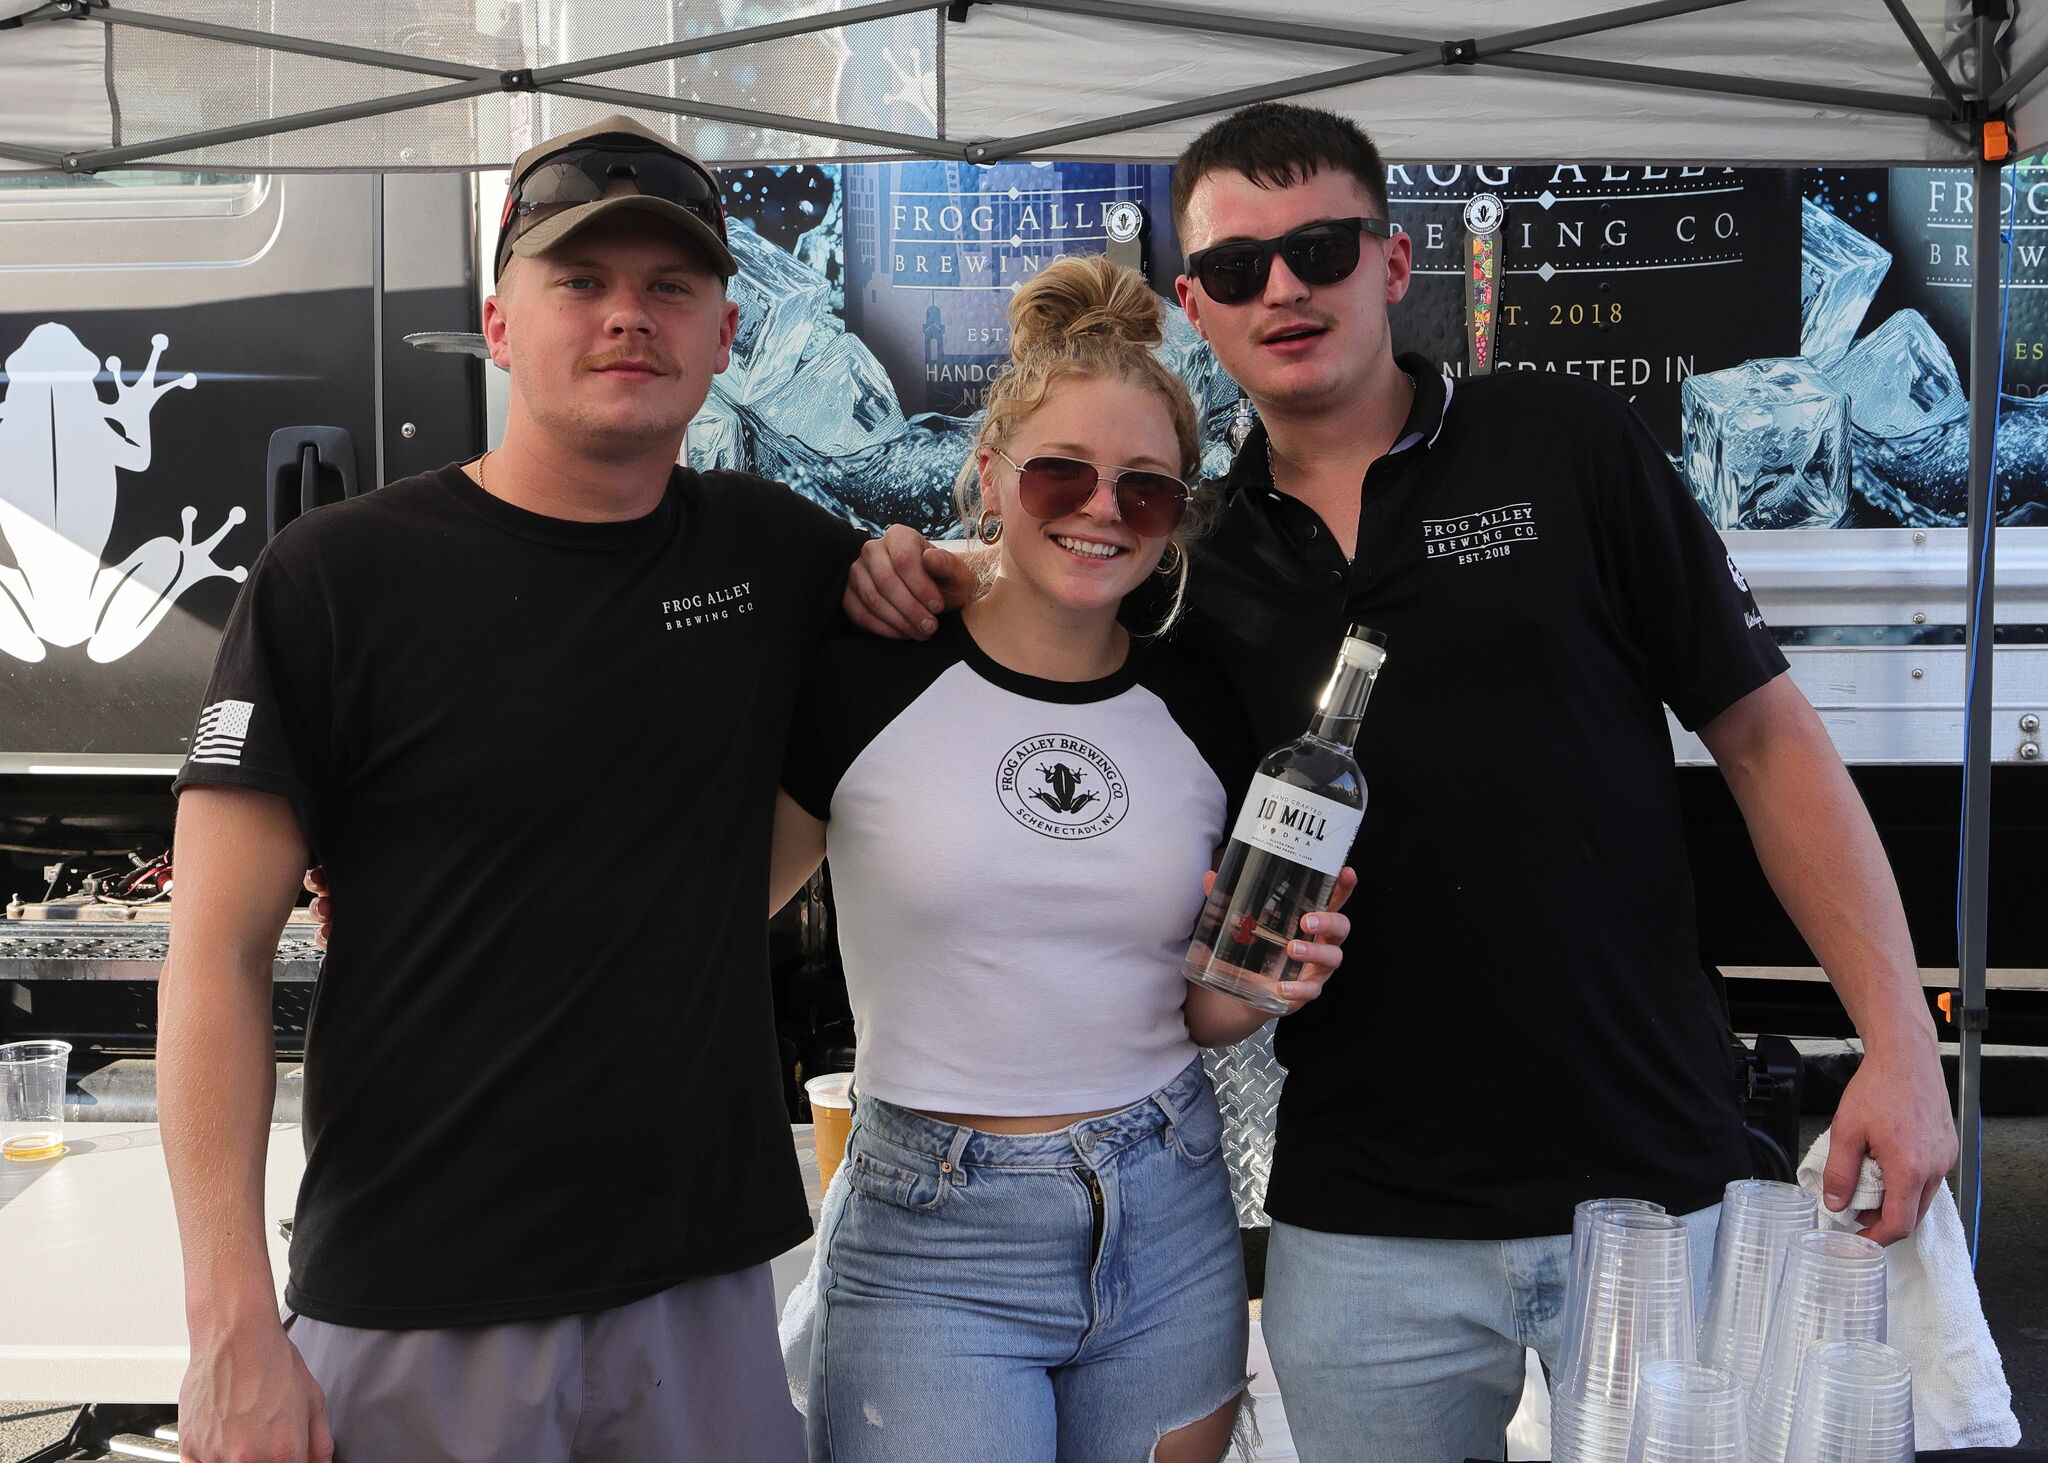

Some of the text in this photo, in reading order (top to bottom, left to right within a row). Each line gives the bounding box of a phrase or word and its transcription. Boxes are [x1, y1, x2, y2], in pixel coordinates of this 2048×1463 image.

[892, 205, 994, 232] FROG
[1676, 212, 1740, 243] CO.
[1929, 243, 2044, 267] BRW
[1549, 302, 1624, 326] 2018
[967, 327, 1009, 343] EST.
[1665, 355, 1694, 384] IN
[1423, 507, 1533, 537] FROG ALLEY
[1427, 526, 1537, 555] BREWING CO.
[662, 582, 751, 614] FROG ALLEY
[666, 610, 729, 631] BREWING
[1001, 738, 1124, 800] FROG ALLEY BREWING CO.
[1270, 794, 1323, 816] HAND CRAFTED
[1016, 808, 1115, 836] SCHENECTADY, NY
[1279, 805, 1327, 842] MILL
